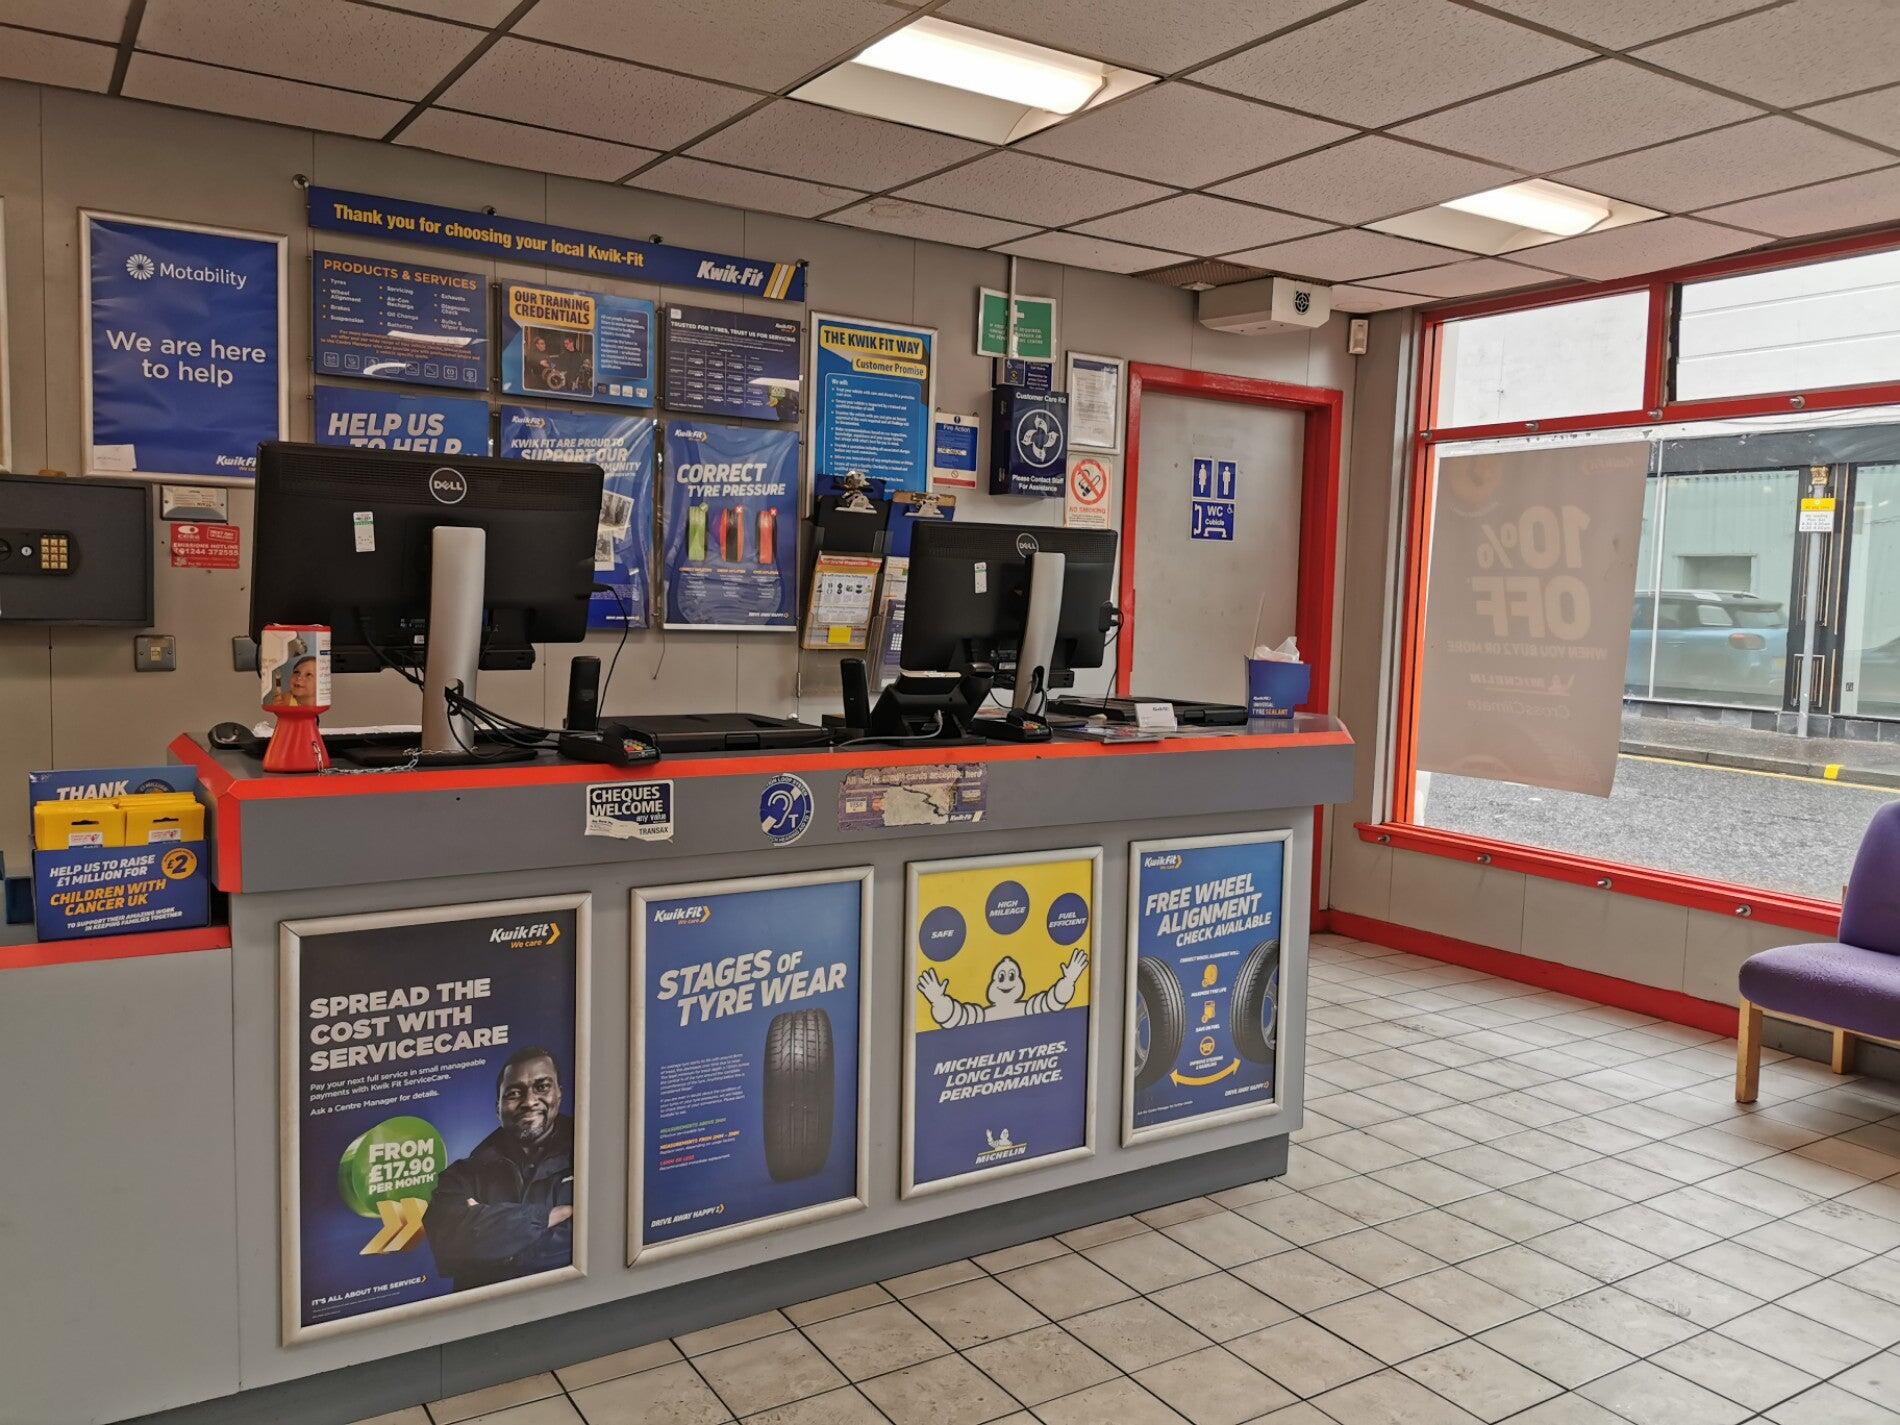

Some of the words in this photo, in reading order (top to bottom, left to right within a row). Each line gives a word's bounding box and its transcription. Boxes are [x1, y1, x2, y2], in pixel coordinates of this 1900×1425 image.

[333, 203, 382, 225] Thank
[386, 211, 415, 231] you
[419, 215, 441, 233] for
[445, 221, 512, 248] choosing
[515, 234, 548, 251] your
[551, 239, 584, 257] local
[588, 245, 644, 267] Kwik-Fit
[159, 262, 247, 290] Motability
[323, 258, 398, 279] PRODUCTS
[401, 270, 412, 281] &
[414, 272, 477, 291] SERVICES
[696, 260, 763, 287] Kwik-Fit
[514, 290, 538, 304] OUR
[540, 294, 590, 312] TRAINING
[514, 303, 590, 325] CREDENTIALS
[105, 330, 151, 353] We
[160, 339, 202, 357] are
[210, 339, 266, 364] here
[824, 330, 846, 345] THE
[848, 332, 877, 350] KWIK
[879, 336, 894, 352] FIT
[896, 340, 921, 356] WAY
[142, 358, 169, 379] to
[178, 361, 234, 388] help
[856, 358, 893, 373] Customer
[894, 363, 924, 377] Promise
[1016, 392, 1043, 401] Customer
[328, 412, 402, 436] HELP
[407, 414, 445, 437] US
[511, 439, 539, 448] KWIK
[541, 439, 558, 448] FIT
[557, 438, 576, 448] ARE
[577, 438, 611, 448] PROUD
[596, 448, 630, 462] OUR
[676, 462, 767, 484] CORRECT
[1012, 474, 1030, 482] Please
[434, 480, 463, 491] DELL
[688, 484, 720, 498] TYRE
[722, 484, 786, 497] PRESSURE
[1029, 484, 1058, 492] Assistance
[1207, 506, 1224, 517] WC
[56, 780, 130, 802] THANK
[592, 786, 660, 803] CHEQUES
[592, 800, 663, 817] WELCOME
[636, 815, 649, 823] any
[639, 826, 669, 836] TRANSAX
[788, 814, 799, 829] T
[50, 864, 82, 878] HELP
[84, 862, 101, 872] US
[104, 860, 119, 870] TO
[120, 854, 156, 868] RAISE
[167, 855, 188, 874] £2
[56, 876, 70, 887] £1
[72, 871, 122, 885] MILLION
[122, 867, 148, 878] FOR
[50, 884, 125, 906] CHILDREN
[128, 879, 167, 895] WITH
[1145, 886, 1193, 917] FREE
[1195, 872, 1255, 905] WHEEL
[64, 897, 125, 916] CANCER
[128, 894, 148, 907] UK
[989, 906, 1026, 917] MILEAGE
[998, 900, 1018, 910] HIGH
[1156, 893, 1262, 937] ALIGNMENT
[76, 918, 106, 928] SUPPORT
[105, 916, 125, 924] THEIR
[126, 911, 154, 921] AMAZING
[155, 907, 176, 916] WORK
[94, 921, 120, 931] KEEPING
[150, 911, 183, 923] TOGETHER
[1048, 918, 1087, 929] EFFICIENT
[1058, 912, 1078, 921] FUEL
[930, 930, 955, 939] SAFE
[1176, 926, 1214, 948] CHECK
[1214, 912, 1273, 938] AVAILABLE
[510, 940, 524, 949] We
[525, 940, 543, 948] care
[656, 950, 773, 1000] STAGES
[776, 951, 803, 974] OF
[310, 986, 430, 1020] SPREAD
[436, 978, 491, 1002] THE
[677, 982, 755, 1027] TYRE
[760, 962, 848, 1008] WEAR
[310, 1016, 390, 1046] COST
[397, 1004, 473, 1034] WITH
[310, 1024, 509, 1073] SERVICECARE
[934, 1051, 1015, 1076] MICHELIN
[1018, 1041, 1069, 1061] TYRES.
[310, 1082, 325, 1093] Pay
[327, 1080, 346, 1091] your
[347, 1076, 365, 1088] next
[366, 1073, 379, 1082] full
[380, 1070, 408, 1082] service
[410, 1069, 417, 1077] in
[418, 1065, 439, 1076] small
[440, 1058, 486, 1074] manageable
[946, 1068, 991, 1088] LONG
[993, 1056, 1058, 1080] LASTING
[310, 1088, 350, 1102] payments
[352, 1085, 369, 1095] with
[370, 1082, 390, 1092] Kwik
[392, 1080, 402, 1089] Fit
[404, 1074, 451, 1087] ServiceCare.
[938, 1070, 1064, 1104] PERFORMANCE.
[310, 1106, 326, 1116] Ask
[334, 1102, 362, 1113] Centre
[364, 1096, 399, 1110] Manager
[400, 1094, 411, 1102] for
[412, 1090, 440, 1100] details.
[368, 1138, 434, 1163] FROM
[975, 1146, 1026, 1165] MICHELIN
[369, 1157, 435, 1183] £17.90
[368, 1182, 394, 1196] PER
[651, 1217, 672, 1228] DRIVE
[673, 1212, 692, 1223] AWAY
[312, 1296, 327, 1306] IT'S
[328, 1294, 344, 1304] ALL
[344, 1288, 372, 1300] ABOUT
[373, 1284, 389, 1294] THE
[390, 1277, 422, 1290] SERVICE
